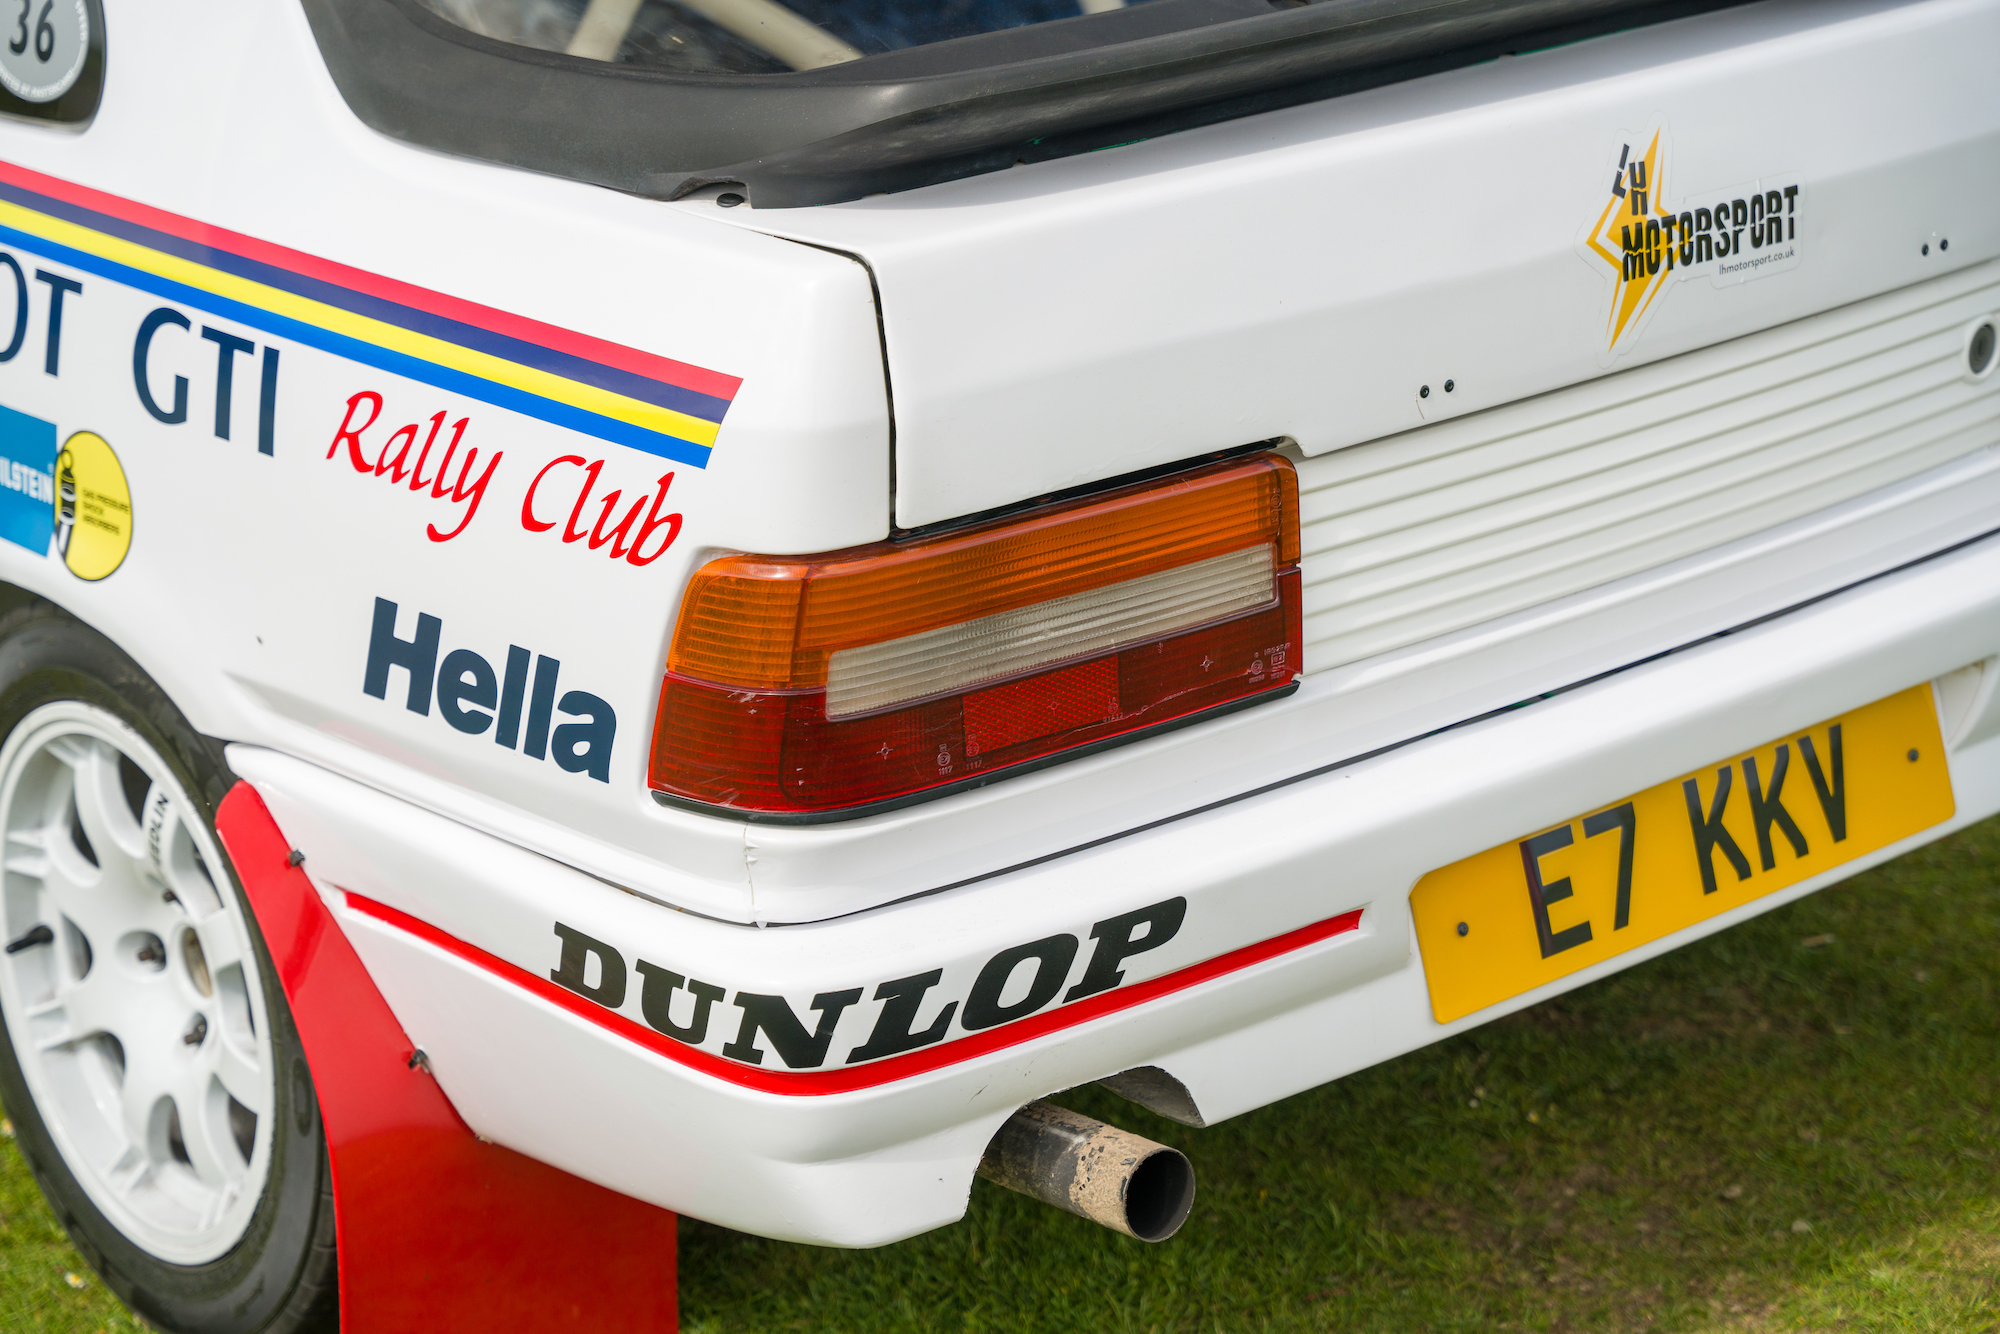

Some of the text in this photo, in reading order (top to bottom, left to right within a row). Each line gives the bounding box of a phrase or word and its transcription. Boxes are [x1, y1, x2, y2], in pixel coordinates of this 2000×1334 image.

[8, 0, 55, 63] 36
[1620, 184, 1799, 283] MOTORSPORT
[1719, 245, 1796, 276] lhmotorsport.co.uk
[132, 306, 281, 459] GTI
[325, 390, 504, 543] Rally
[520, 454, 684, 567] Club
[362, 595, 618, 785] Hella
[1518, 722, 1848, 960] E7 KKV
[550, 895, 1188, 1070] DUNLOP
